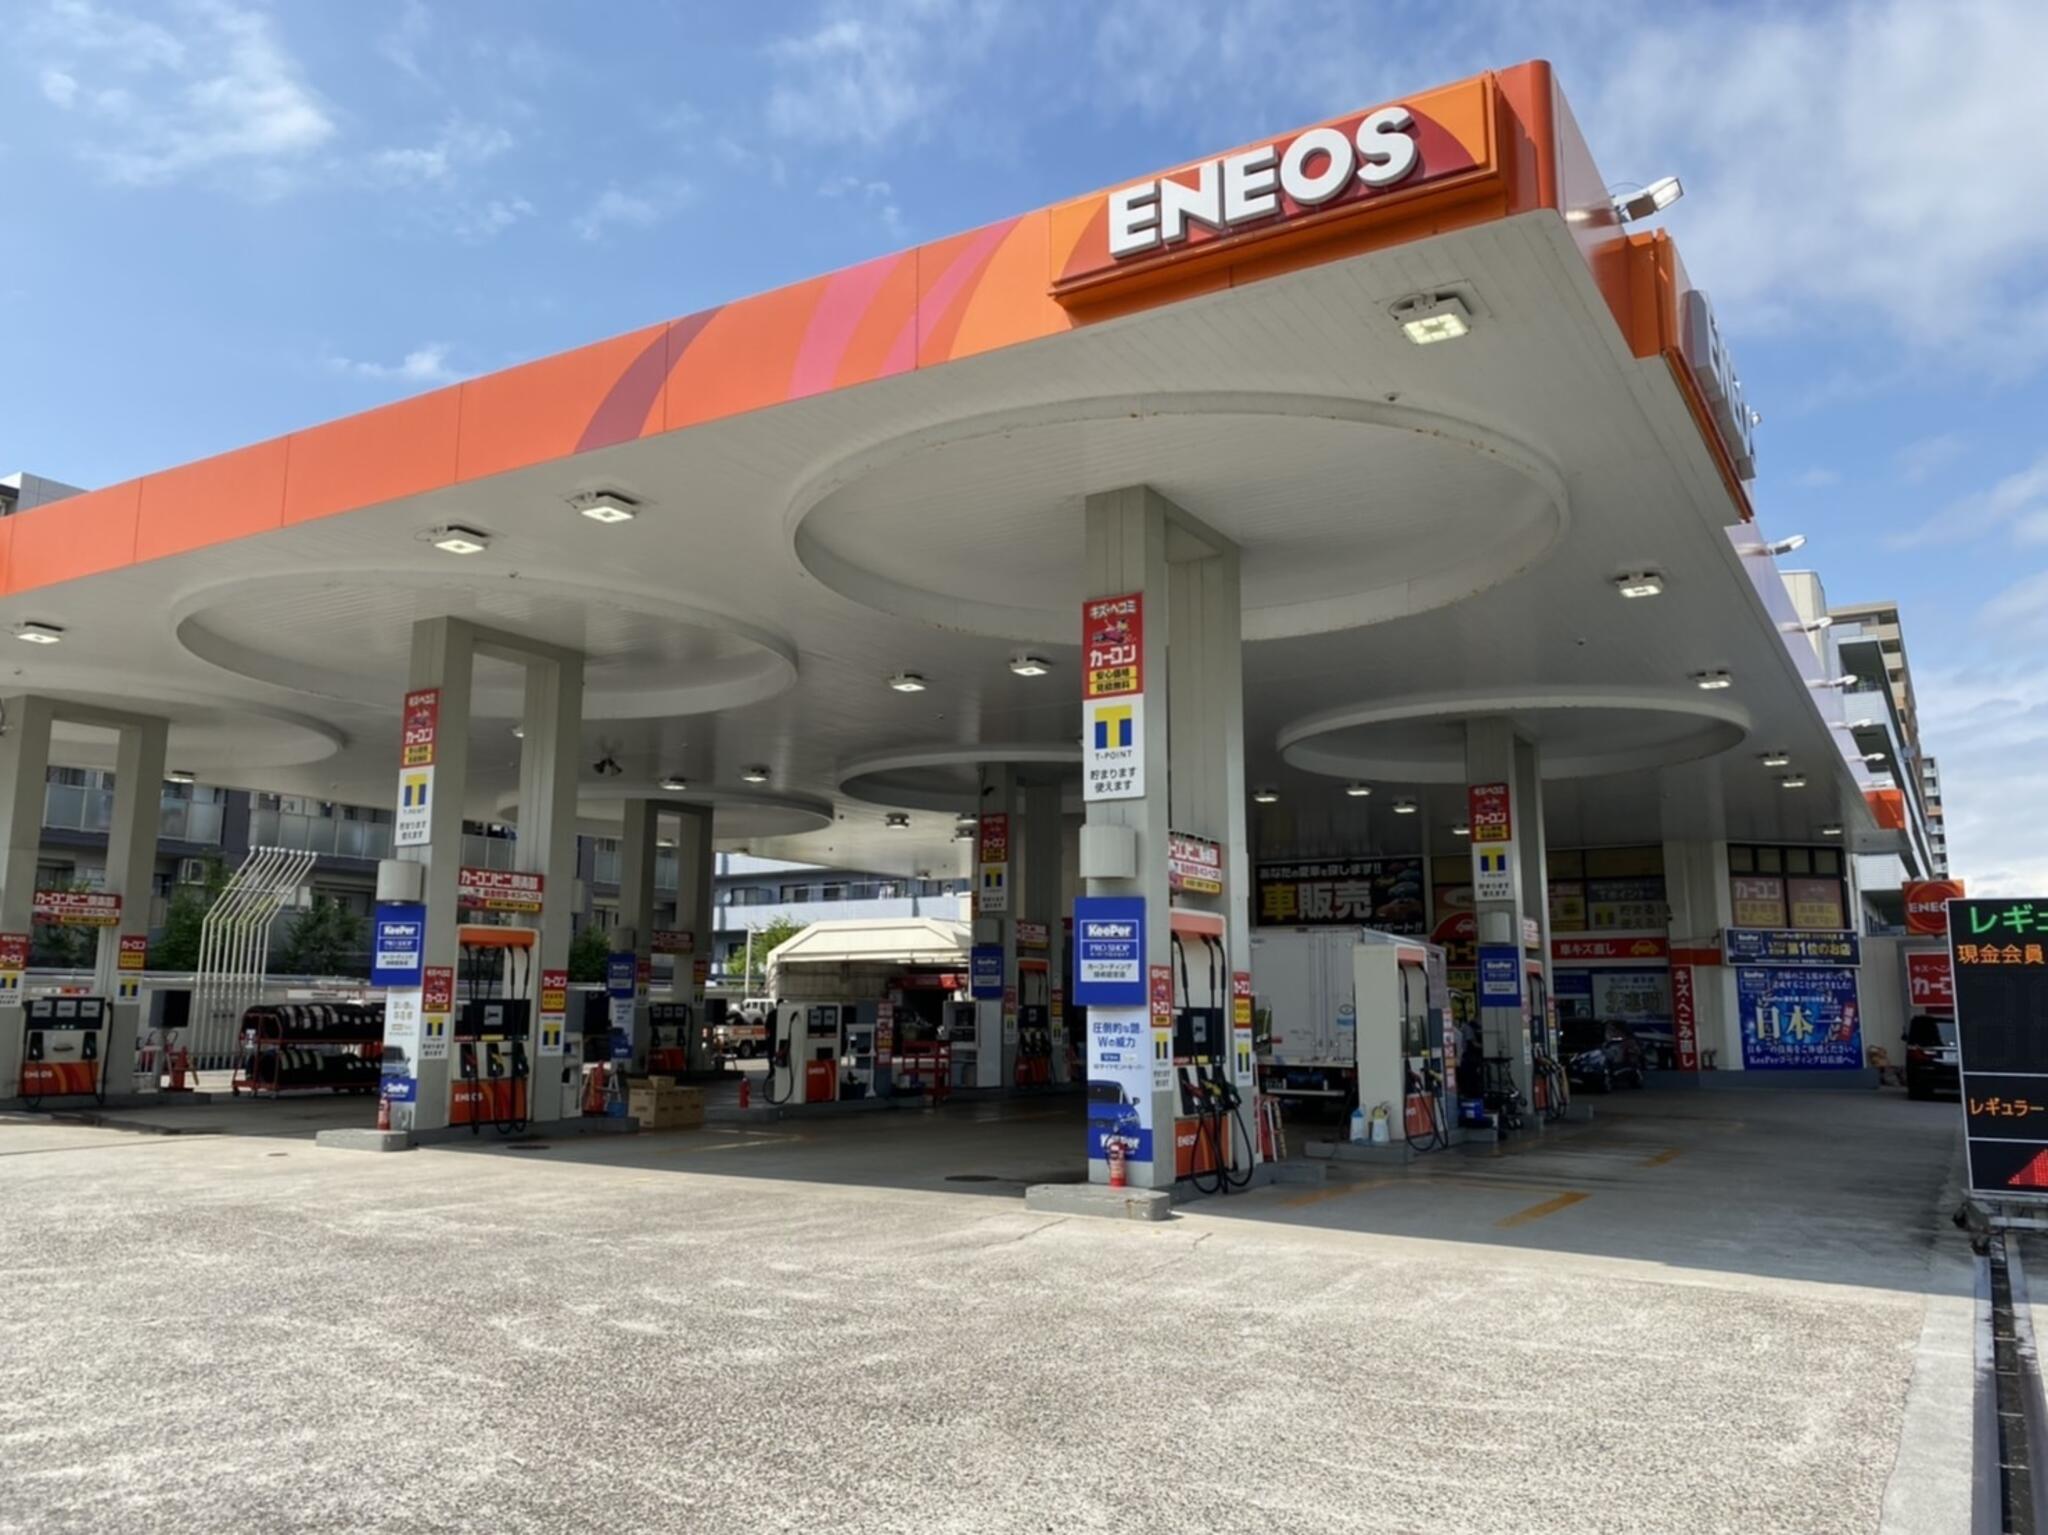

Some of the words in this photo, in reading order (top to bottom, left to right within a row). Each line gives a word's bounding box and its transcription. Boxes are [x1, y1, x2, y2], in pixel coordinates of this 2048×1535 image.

[1109, 106, 1418, 258] ENEOS
[1095, 750, 1132, 760] T-POINT
[1090, 767, 1136, 780] 貯まります
[1095, 780, 1132, 793] 使えます
[1263, 881, 1372, 920] 車販売
[1908, 902, 1947, 913] ENEO
[1088, 924, 1132, 937] KeePer
[1090, 944, 1106, 952] PRO
[1559, 943, 1616, 955] 車キズ直し
[1957, 944, 2046, 964] 現金会員
[1674, 969, 1694, 1068] キズ・へこみ直し
[1755, 1004, 1843, 1040] 日本一
[1098, 1036, 1136, 1048] Wの威力
[1970, 1098, 2045, 1117] レギュラー
